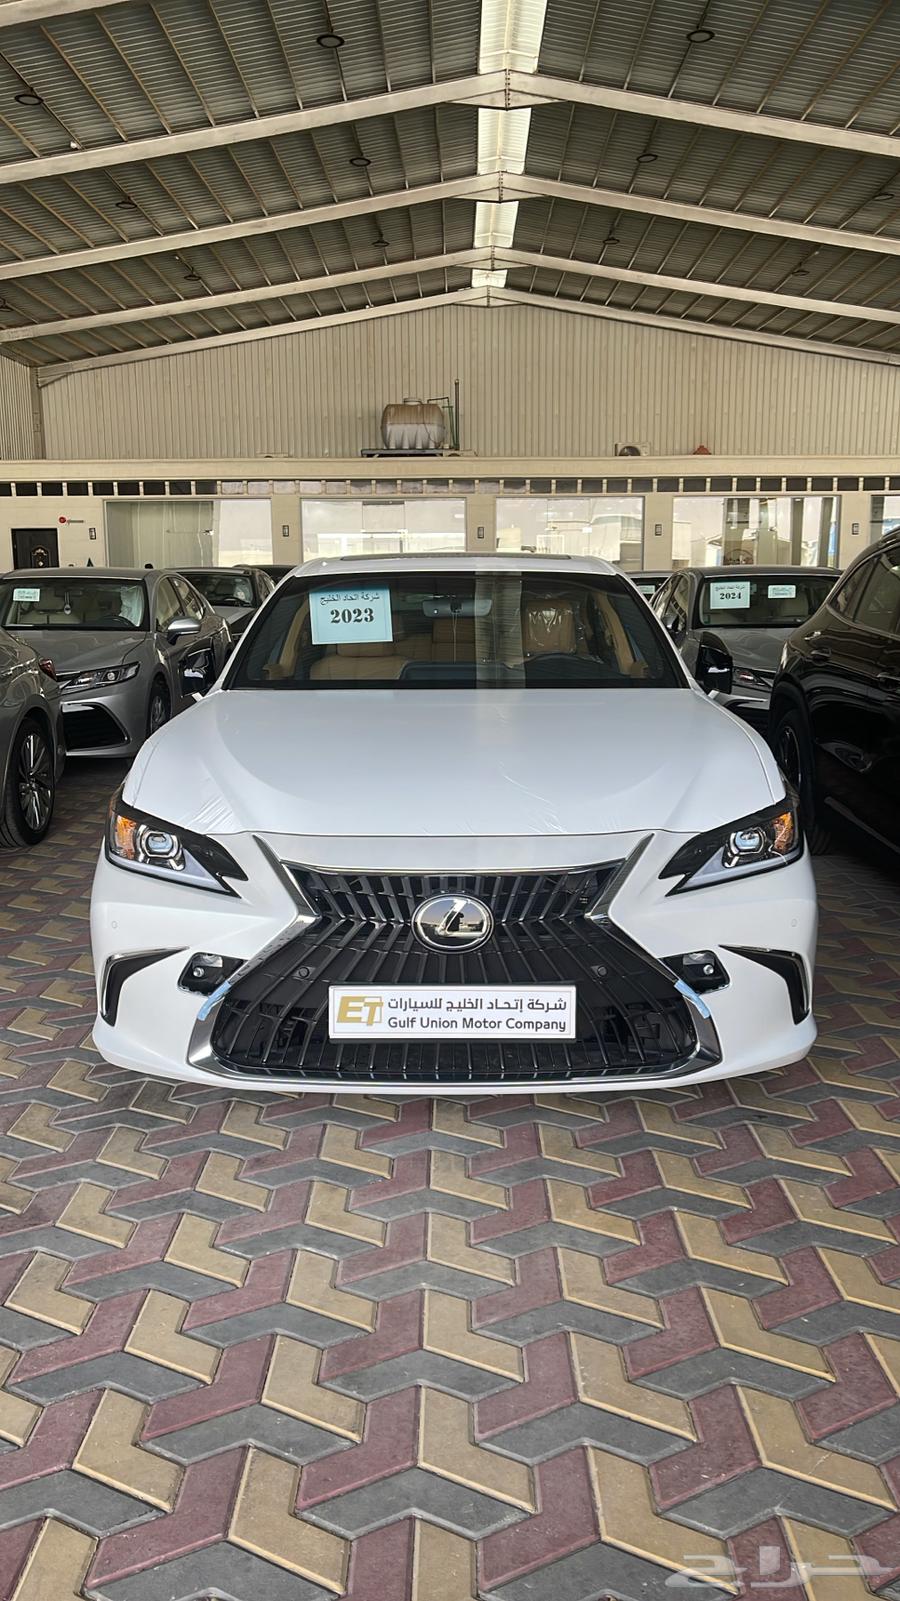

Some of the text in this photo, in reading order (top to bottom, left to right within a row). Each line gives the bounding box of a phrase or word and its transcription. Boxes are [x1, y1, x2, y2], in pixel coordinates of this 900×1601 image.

[361, 592, 380, 602] شركة
[719, 592, 742, 600] 2024
[330, 608, 374, 624] 2023
[336, 995, 384, 1026] ET
[388, 998, 442, 1012] للسيارات
[446, 998, 483, 1012] الخليج
[527, 998, 567, 1013] شركة
[388, 1017, 566, 1032] Gulf Union Motor Company
